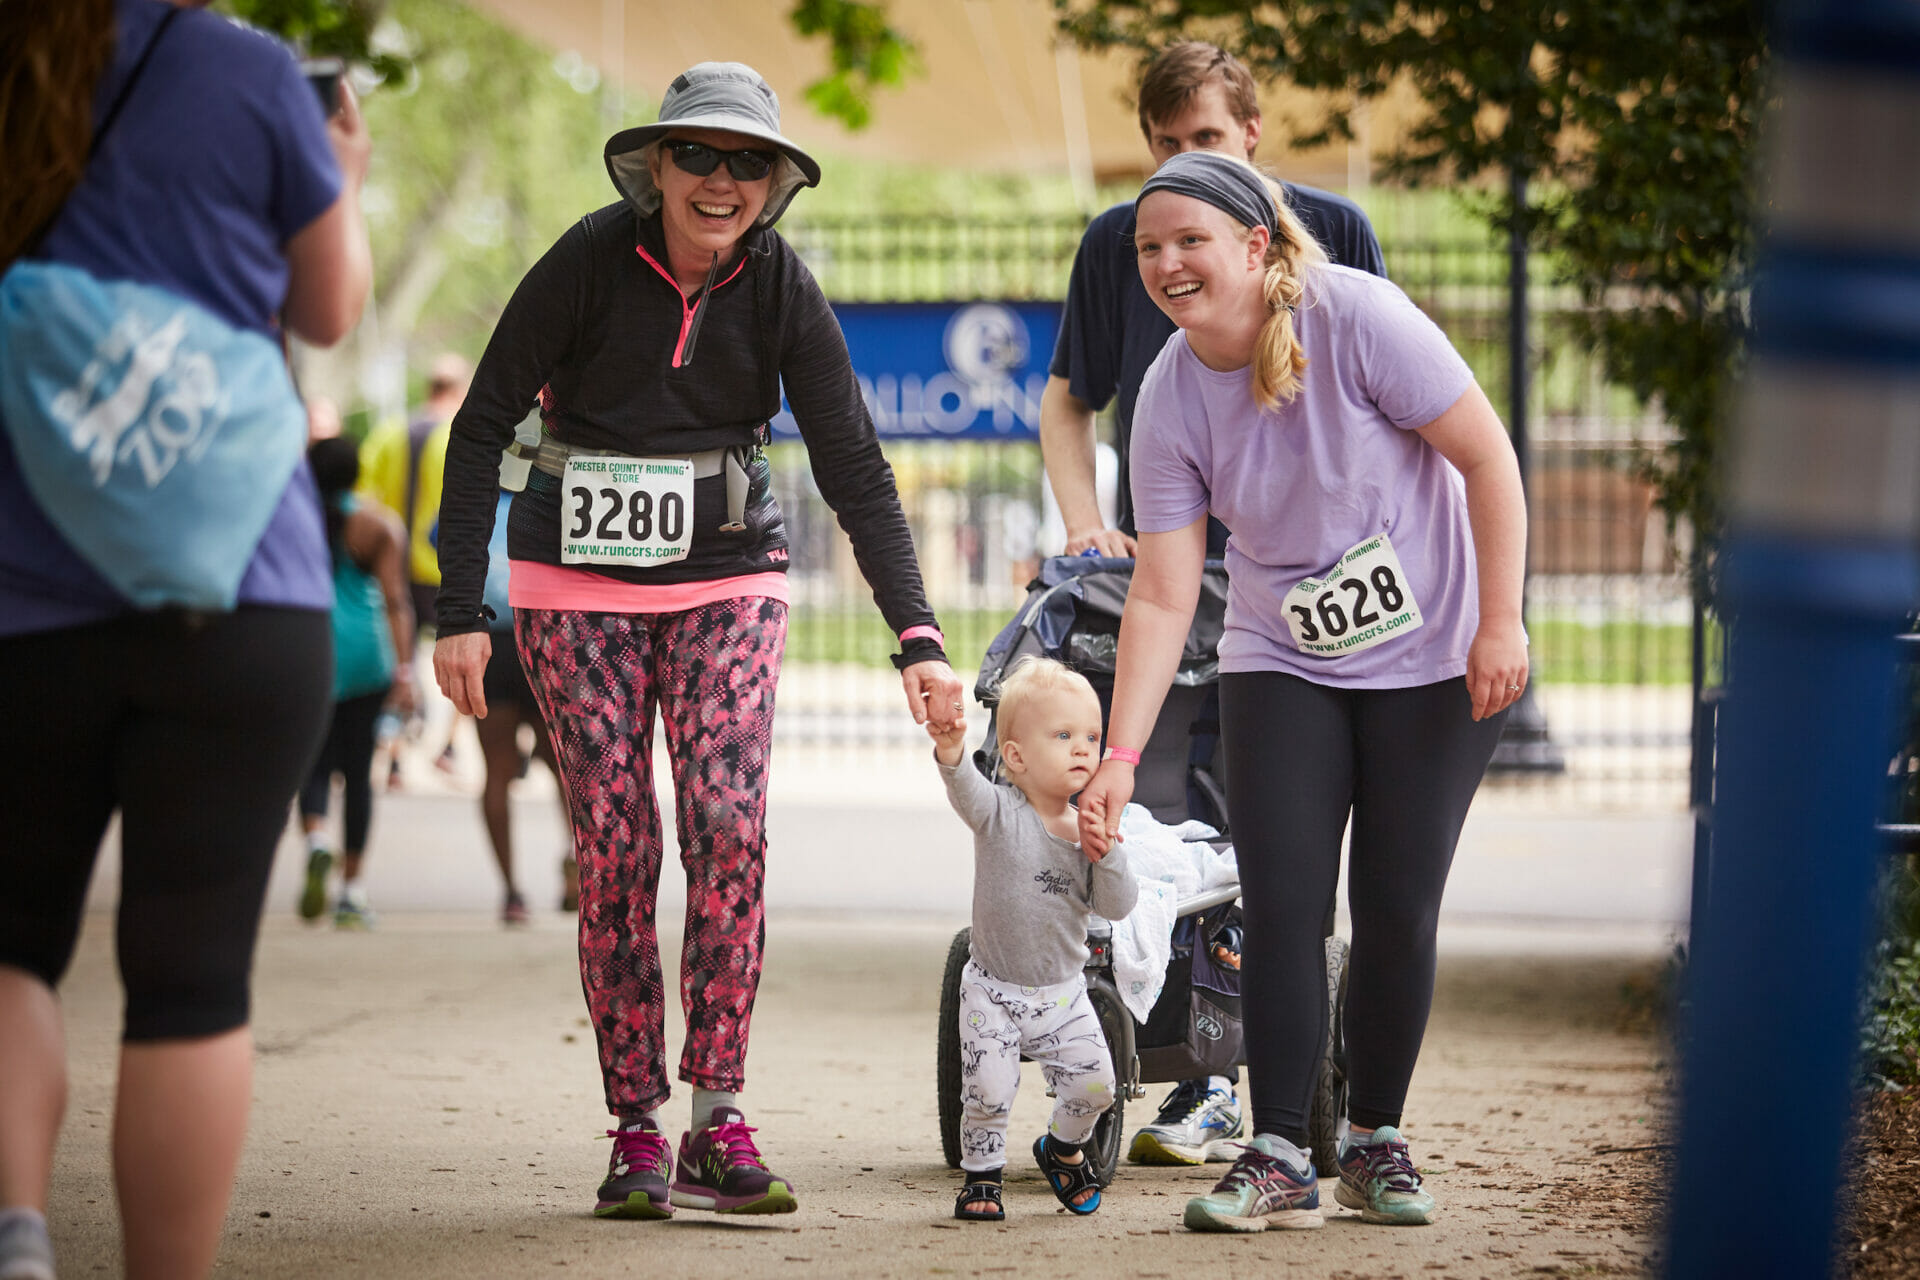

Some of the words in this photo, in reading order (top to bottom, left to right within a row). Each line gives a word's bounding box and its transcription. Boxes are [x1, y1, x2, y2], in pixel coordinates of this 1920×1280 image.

[572, 461, 607, 473] CHESTER
[608, 463, 644, 474] COUNTY
[646, 465, 685, 476] RUNNING
[612, 474, 640, 484] STORE
[569, 486, 684, 542] 3280
[567, 544, 681, 558] www.runccrs.com
[1345, 539, 1381, 563] RUNNING
[1322, 567, 1345, 588] STORE
[1290, 565, 1404, 642] 3628
